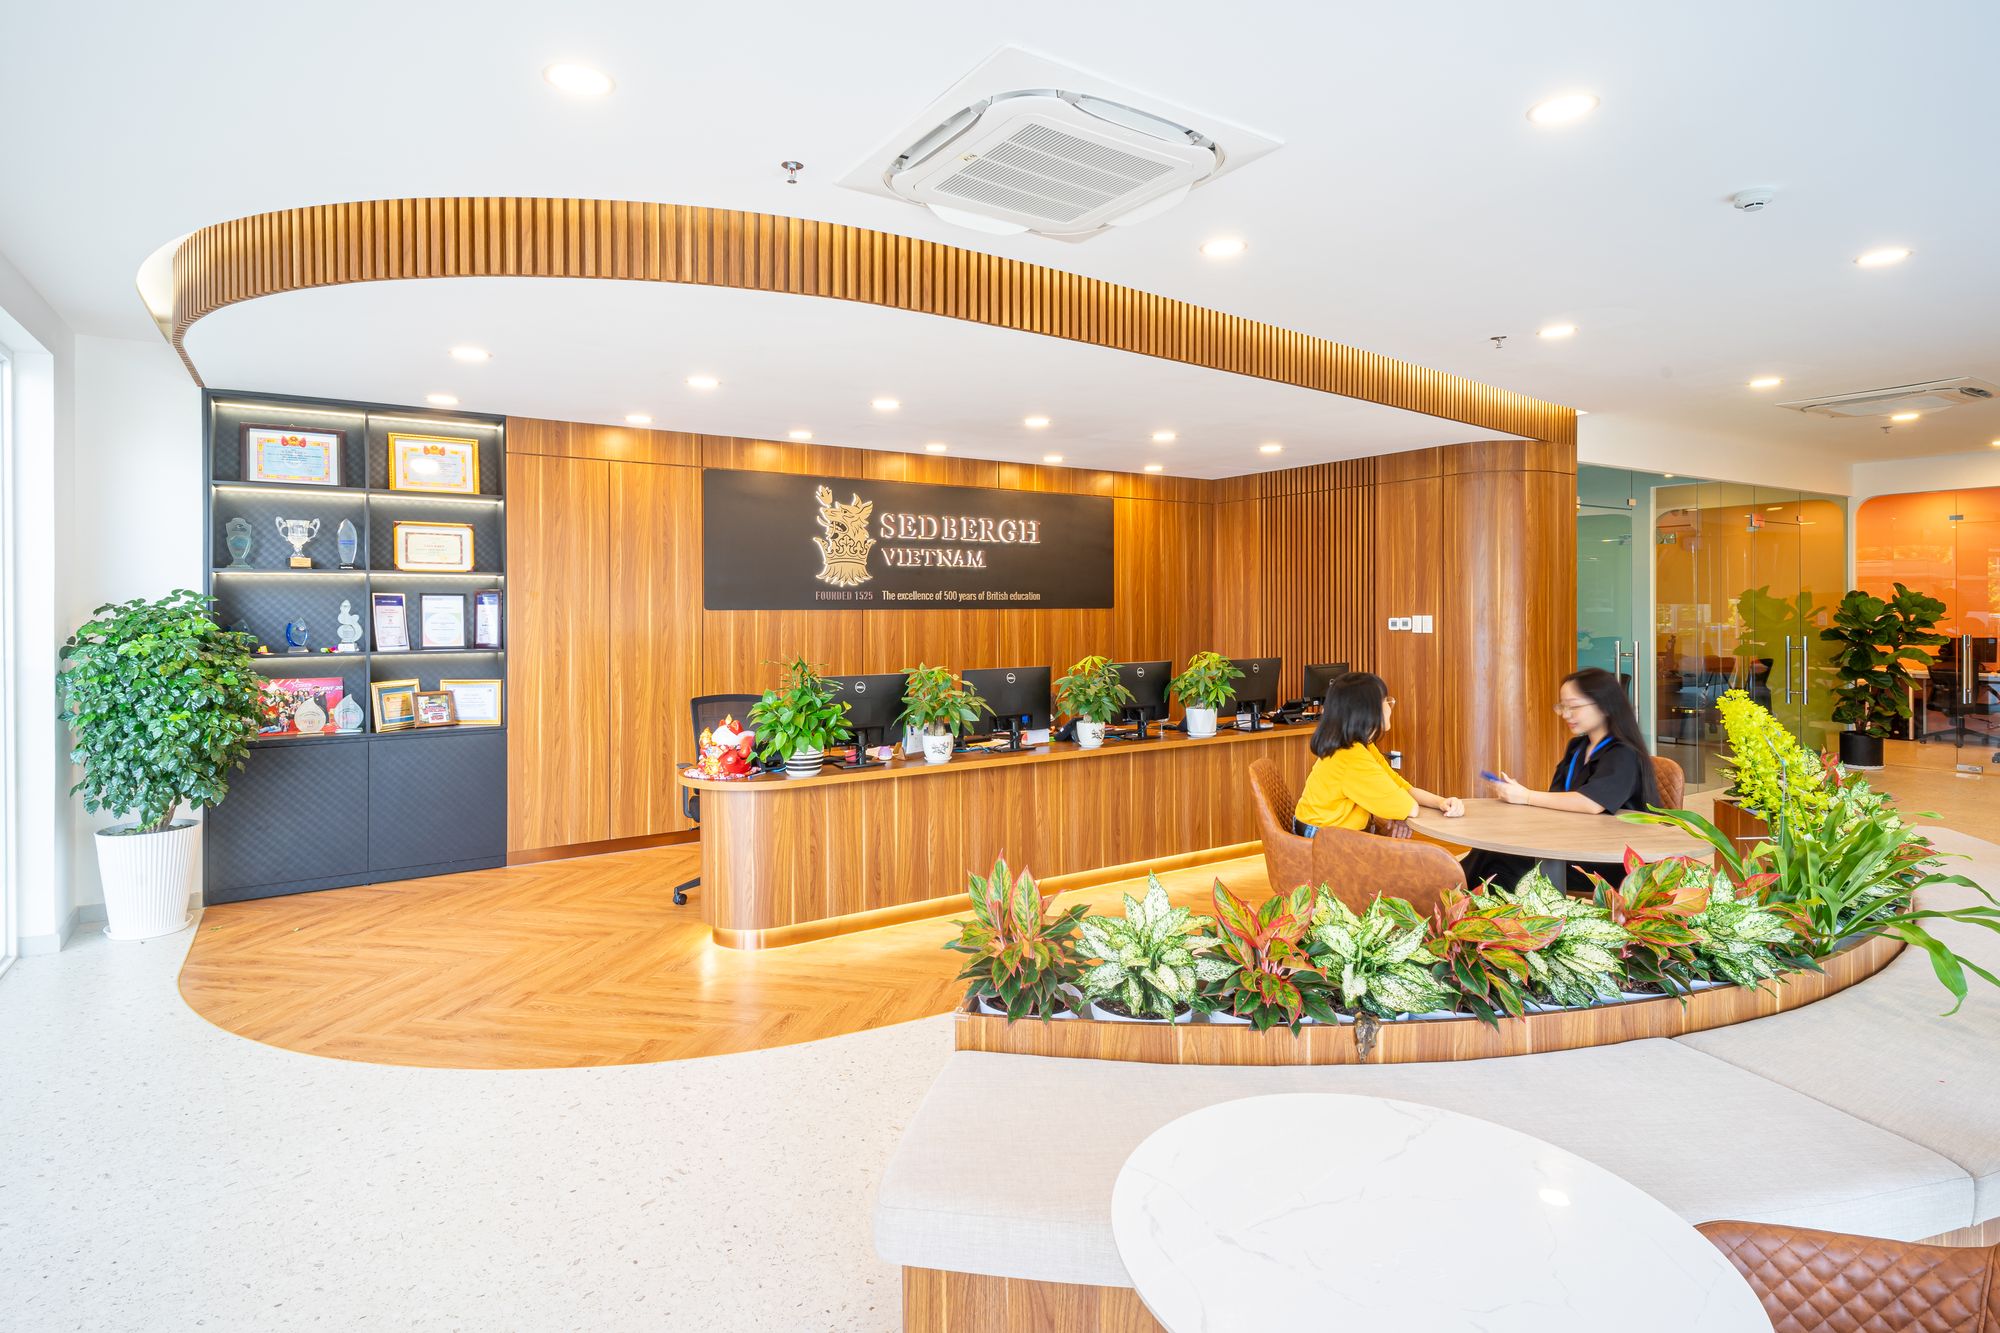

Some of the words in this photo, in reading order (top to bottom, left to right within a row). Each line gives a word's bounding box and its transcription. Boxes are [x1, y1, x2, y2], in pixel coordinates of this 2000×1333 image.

[880, 512, 1041, 544] SEDBERGH
[881, 547, 987, 568] VIETNAM
[815, 591, 852, 601] FOUNDED
[854, 591, 873, 601] 1525
[882, 590, 896, 601] The
[897, 590, 934, 601] excellence
[935, 591, 943, 601] of
[943, 591, 958, 601] 500
[958, 591, 977, 603] years
[978, 591, 986, 601] of
[986, 591, 1009, 601] British
[1009, 591, 1041, 601] education
